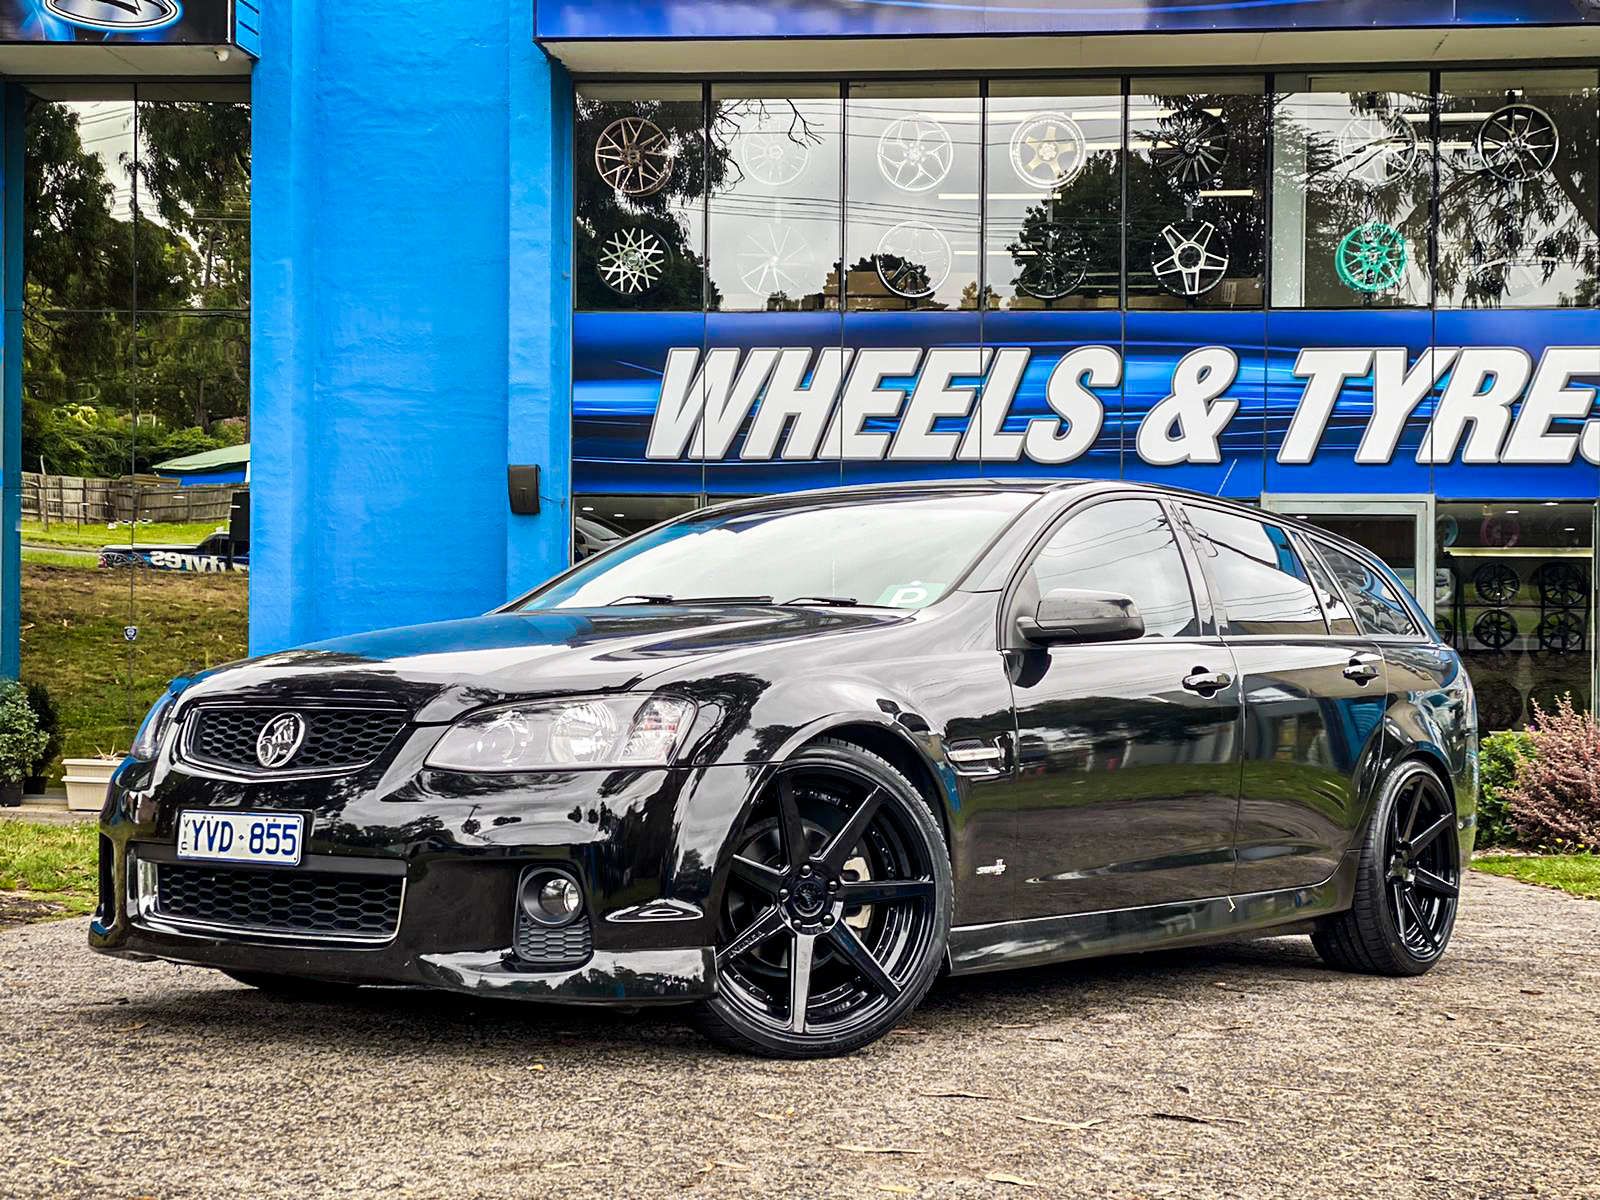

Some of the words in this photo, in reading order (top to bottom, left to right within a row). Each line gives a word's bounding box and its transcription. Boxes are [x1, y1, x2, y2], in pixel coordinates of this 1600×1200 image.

[645, 346, 1122, 464] WHEELS
[1135, 345, 1239, 465] &
[1276, 346, 1600, 465] TYRE
[887, 587, 928, 607] P
[180, 819, 190, 851] VIC
